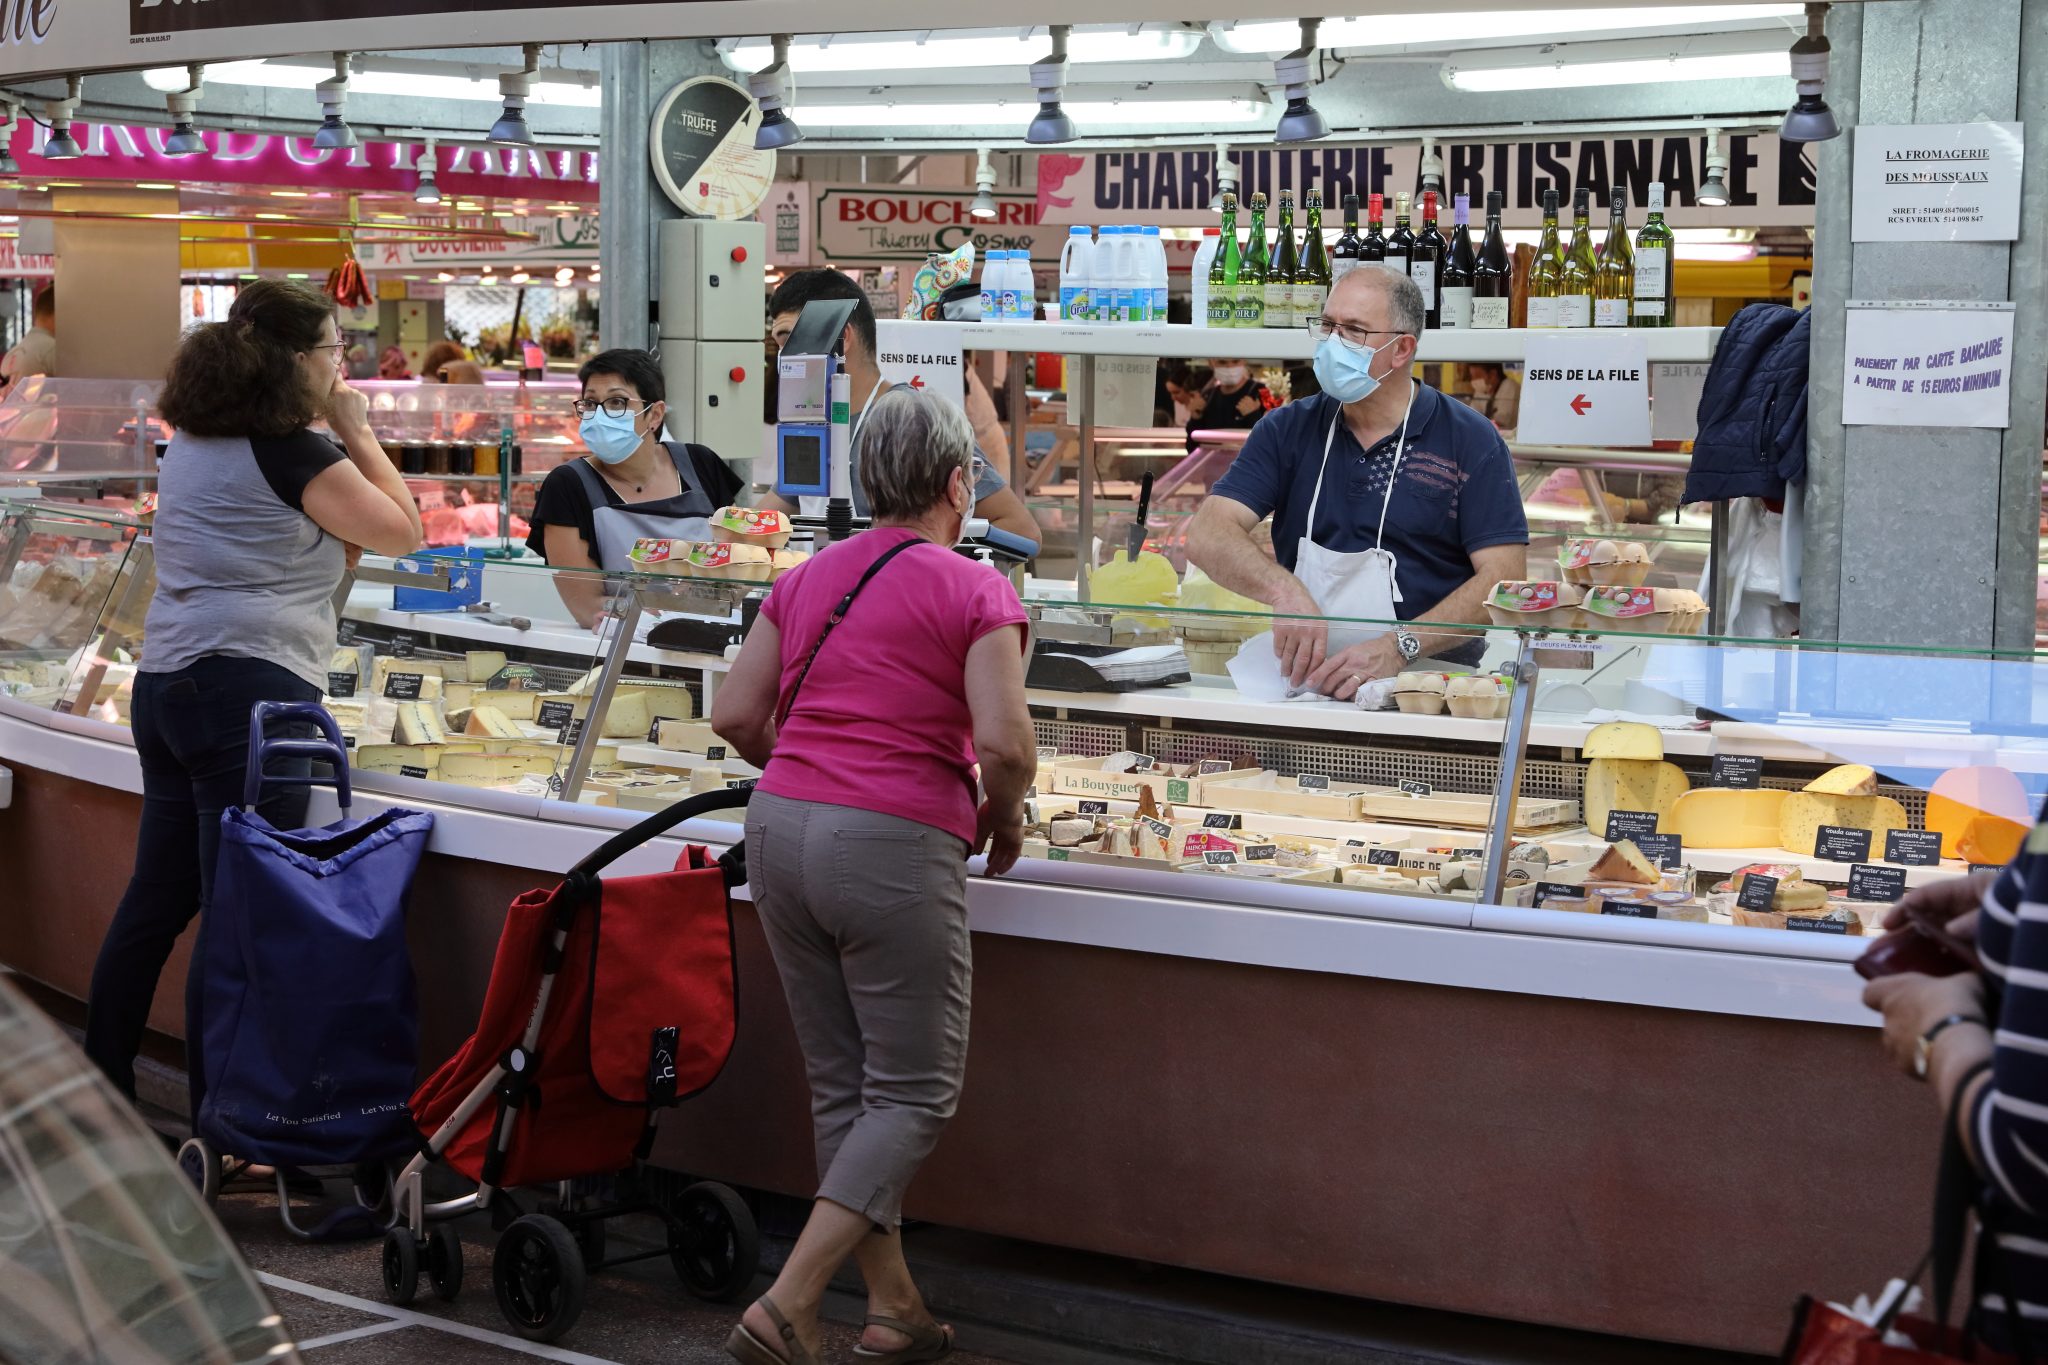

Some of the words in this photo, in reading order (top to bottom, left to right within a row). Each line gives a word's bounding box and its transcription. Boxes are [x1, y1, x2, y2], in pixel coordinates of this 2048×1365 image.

[681, 113, 717, 132] TRUFFE
[1886, 150, 1902, 160] LA
[1906, 148, 1990, 160] FROMAGERIE
[1094, 147, 1393, 210] CHARUTERIE
[1885, 173, 1909, 182] DES
[1911, 171, 1988, 182] MOUSSEAUX
[1887, 216, 1903, 224] RCS
[1971, 215, 1984, 223] 847
[857, 226, 930, 249] Thierry
[934, 226, 1035, 251] Cosmo
[880, 353, 904, 363] SENS
[906, 354, 919, 364] DE
[921, 355, 934, 365] LA
[936, 355, 957, 365] FILE
[1854, 357, 1898, 371] PAIEMENT
[1903, 357, 1921, 371] PAR
[1926, 350, 1955, 369] CARTE
[1960, 337, 2003, 364] BANCAIRE
[1529, 369, 1563, 381] SENS
[1566, 369, 1584, 381] DE
[1587, 369, 1605, 381] LA
[1609, 370, 1639, 381] FILE
[1854, 374, 1861, 385] A
[1866, 376, 1897, 391] PARTIR
[1902, 380, 1914, 393] DE
[1921, 380, 1931, 394] 15
[1931, 377, 1962, 394] EUROS
[1962, 369, 2002, 392] MINIMUM
[1065, 776, 1077, 788] La
[1083, 778, 1146, 797] Bouyguet
[1891, 831, 1920, 839] Mimolette
[1920, 833, 1937, 841] jeune
[1399, 858, 1425, 870] AURE
[1854, 865, 1880, 875] Munster
[1879, 869, 1901, 877] nature
[1788, 919, 1814, 928] Boulette
[361, 1106, 377, 1115] Let
[379, 1104, 398, 1112] You
[265, 1112, 279, 1122] Let
[281, 1116, 299, 1125] You
[301, 1111, 341, 1124] Satisfied
